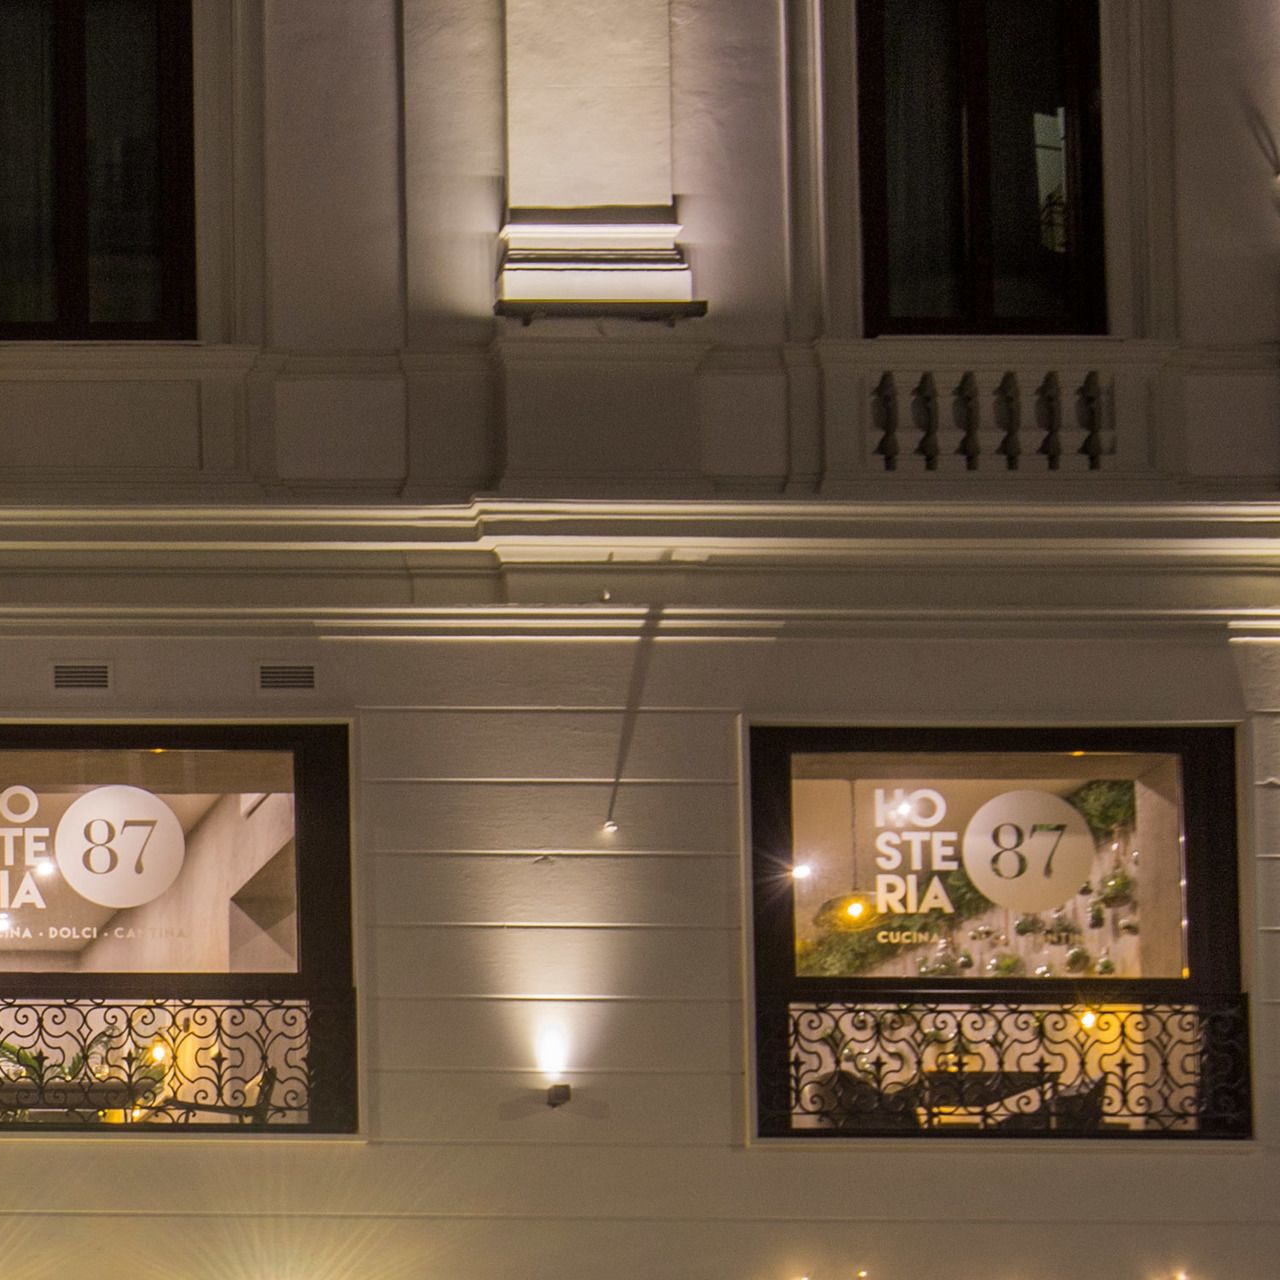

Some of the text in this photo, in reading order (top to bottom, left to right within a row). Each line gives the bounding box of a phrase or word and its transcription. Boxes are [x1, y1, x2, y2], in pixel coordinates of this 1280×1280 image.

[874, 788, 947, 828] HO
[82, 818, 159, 875] 87
[875, 831, 959, 871] STE
[991, 822, 1068, 880] 87
[876, 874, 955, 914] RIA
[48, 926, 97, 939] DOLCI
